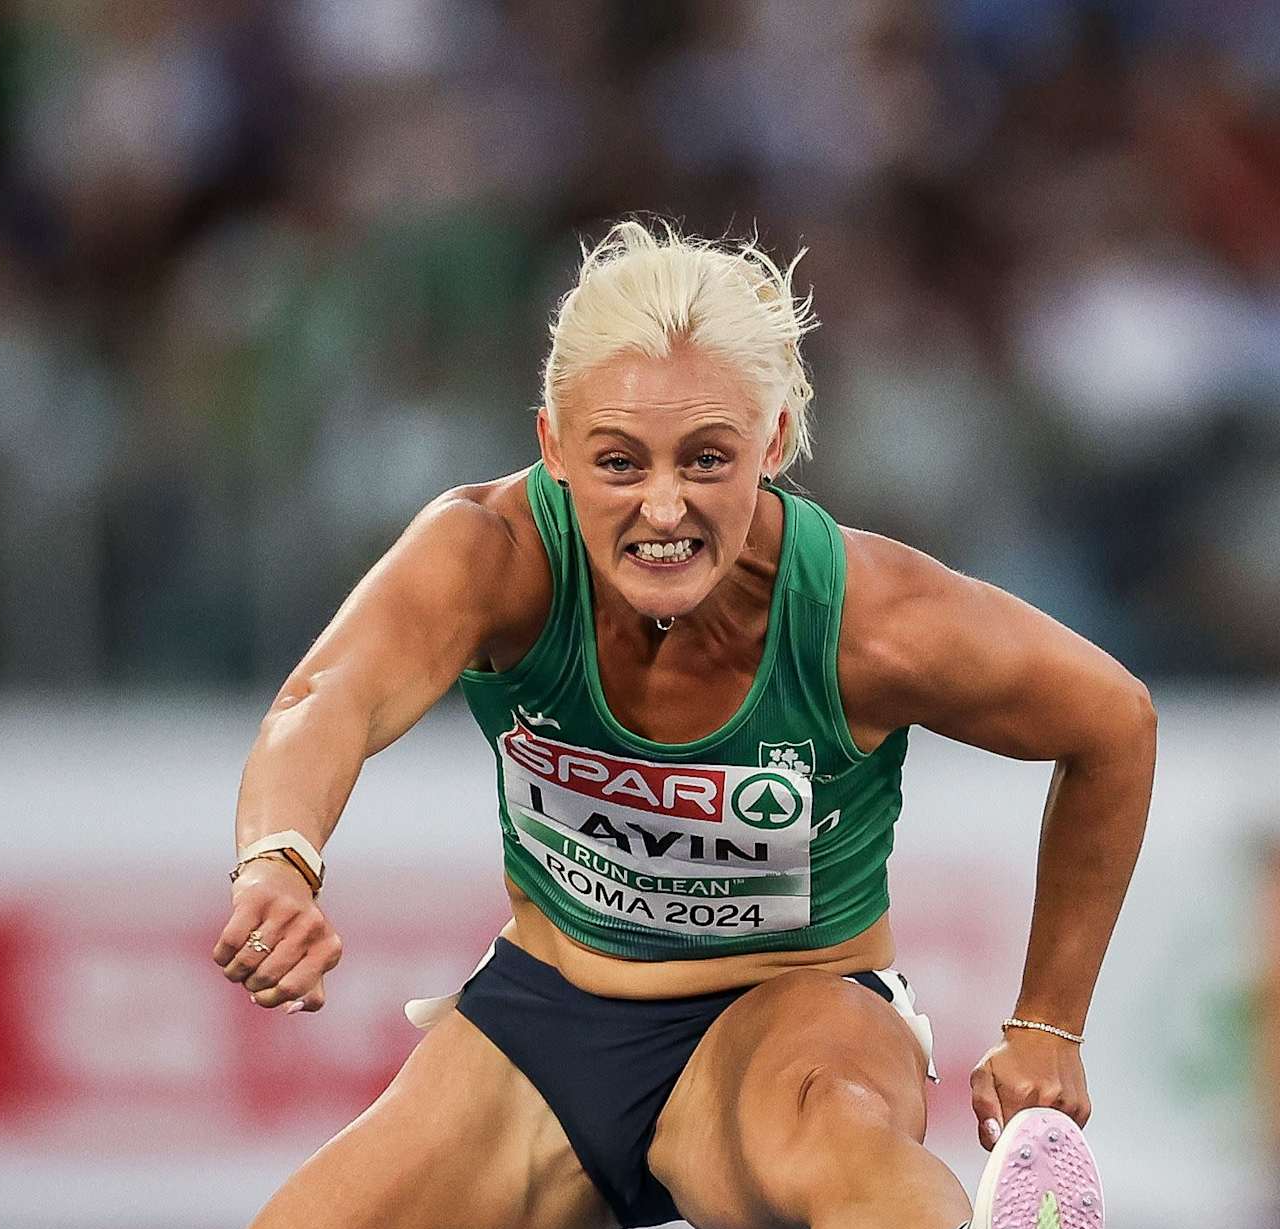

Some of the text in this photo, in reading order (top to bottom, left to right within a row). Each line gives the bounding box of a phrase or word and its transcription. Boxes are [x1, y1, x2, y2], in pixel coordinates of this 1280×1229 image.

[503, 734, 717, 815] SPAR
[546, 853, 765, 928] ROMA 2024
[563, 840, 569, 855] I
[575, 845, 635, 885] RUN
